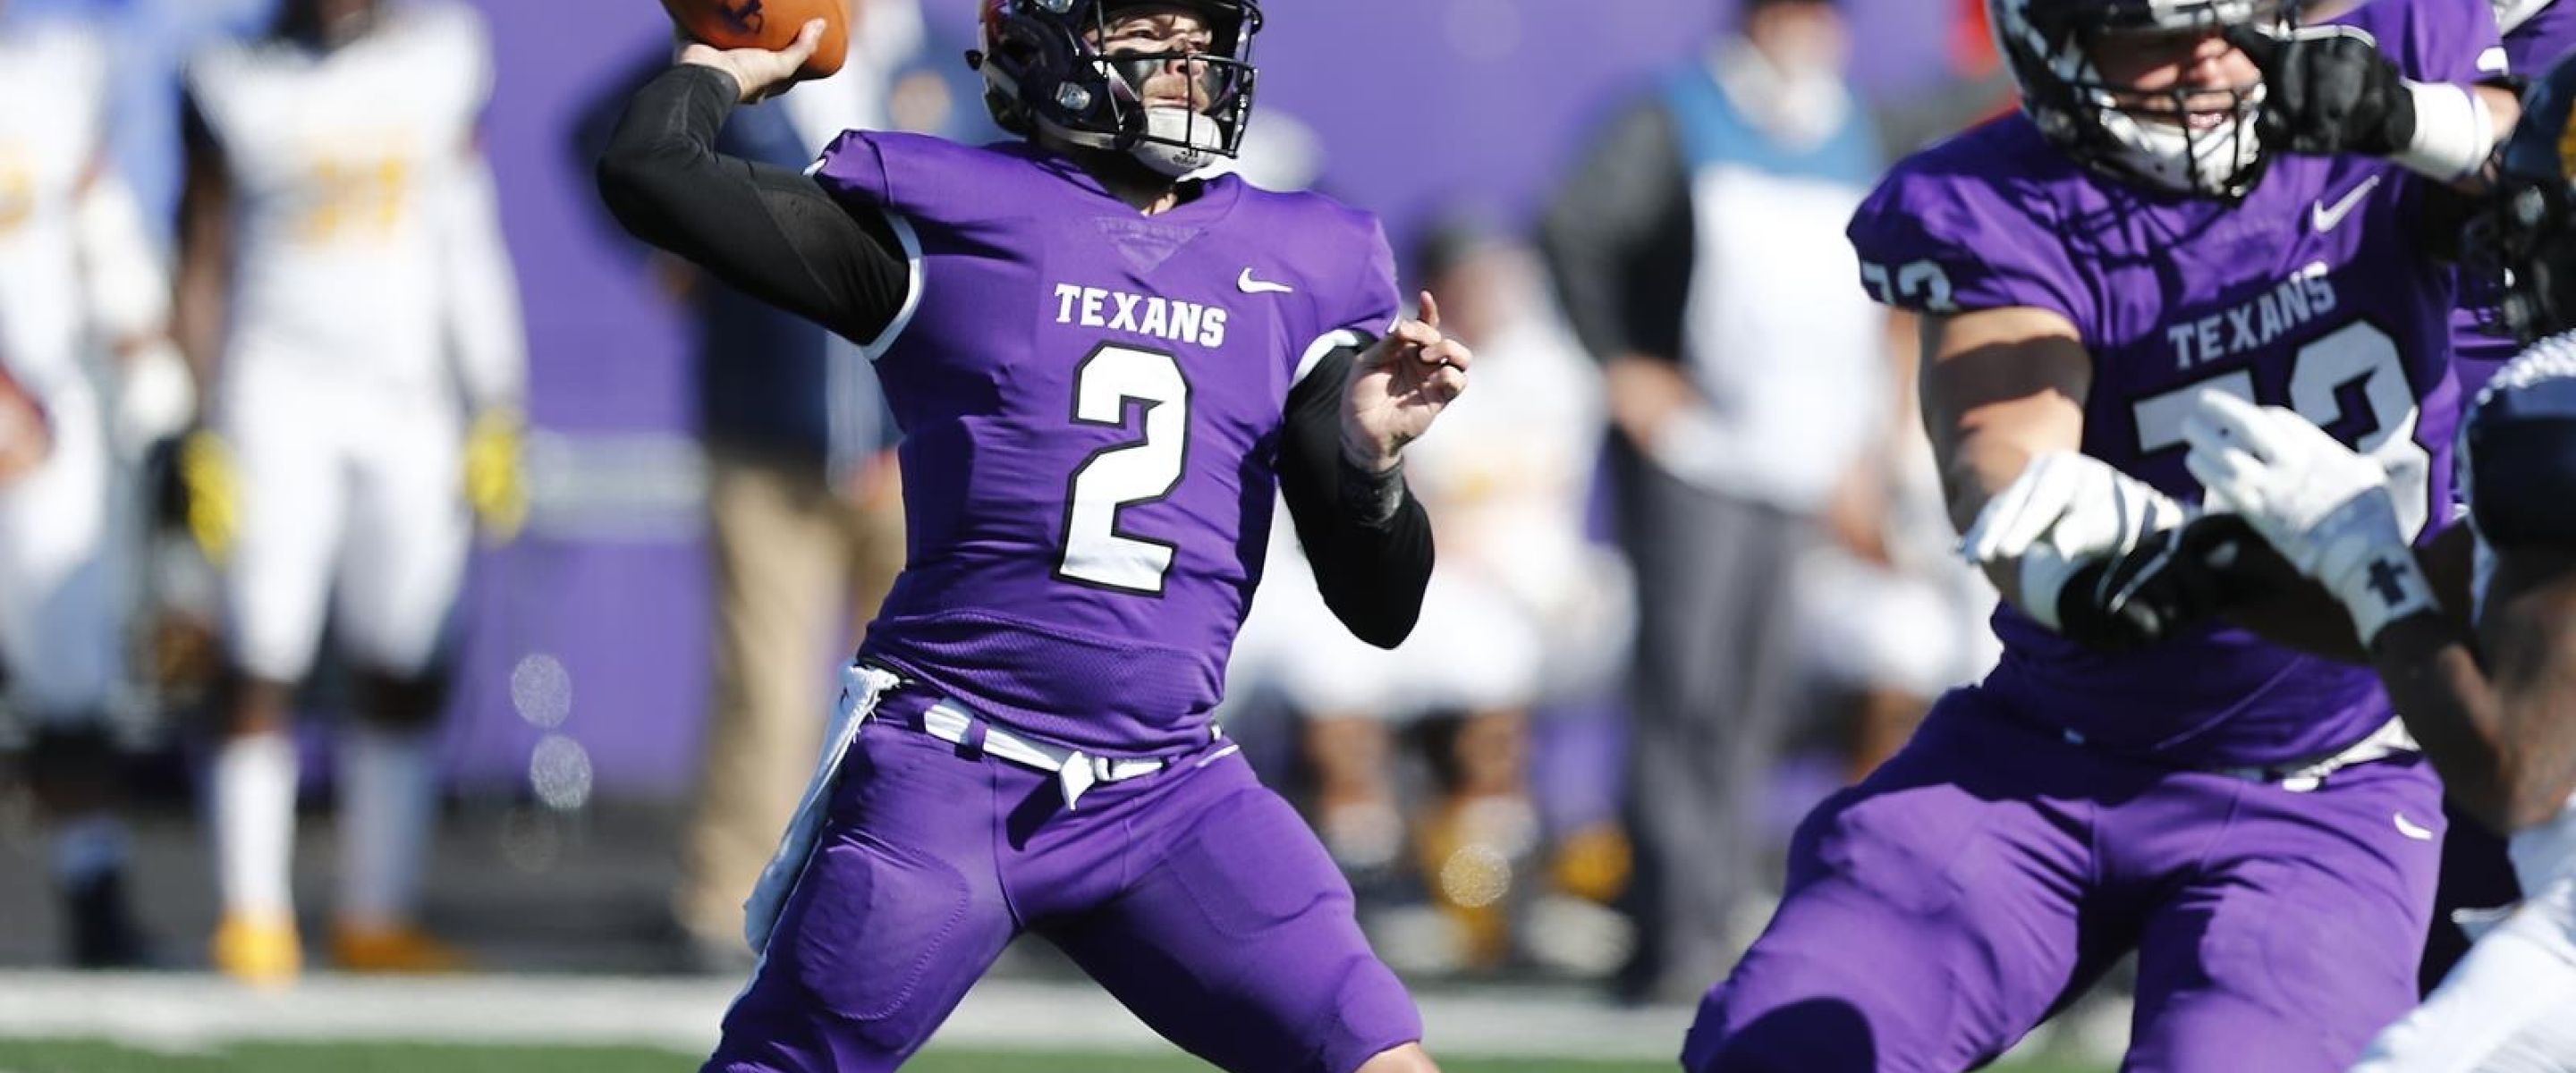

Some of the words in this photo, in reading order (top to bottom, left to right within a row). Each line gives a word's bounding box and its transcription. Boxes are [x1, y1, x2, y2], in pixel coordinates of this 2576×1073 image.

[1055, 283, 1227, 348] TEXANS
[2167, 261, 2337, 370] TEXANS
[1052, 341, 1191, 597] 2
